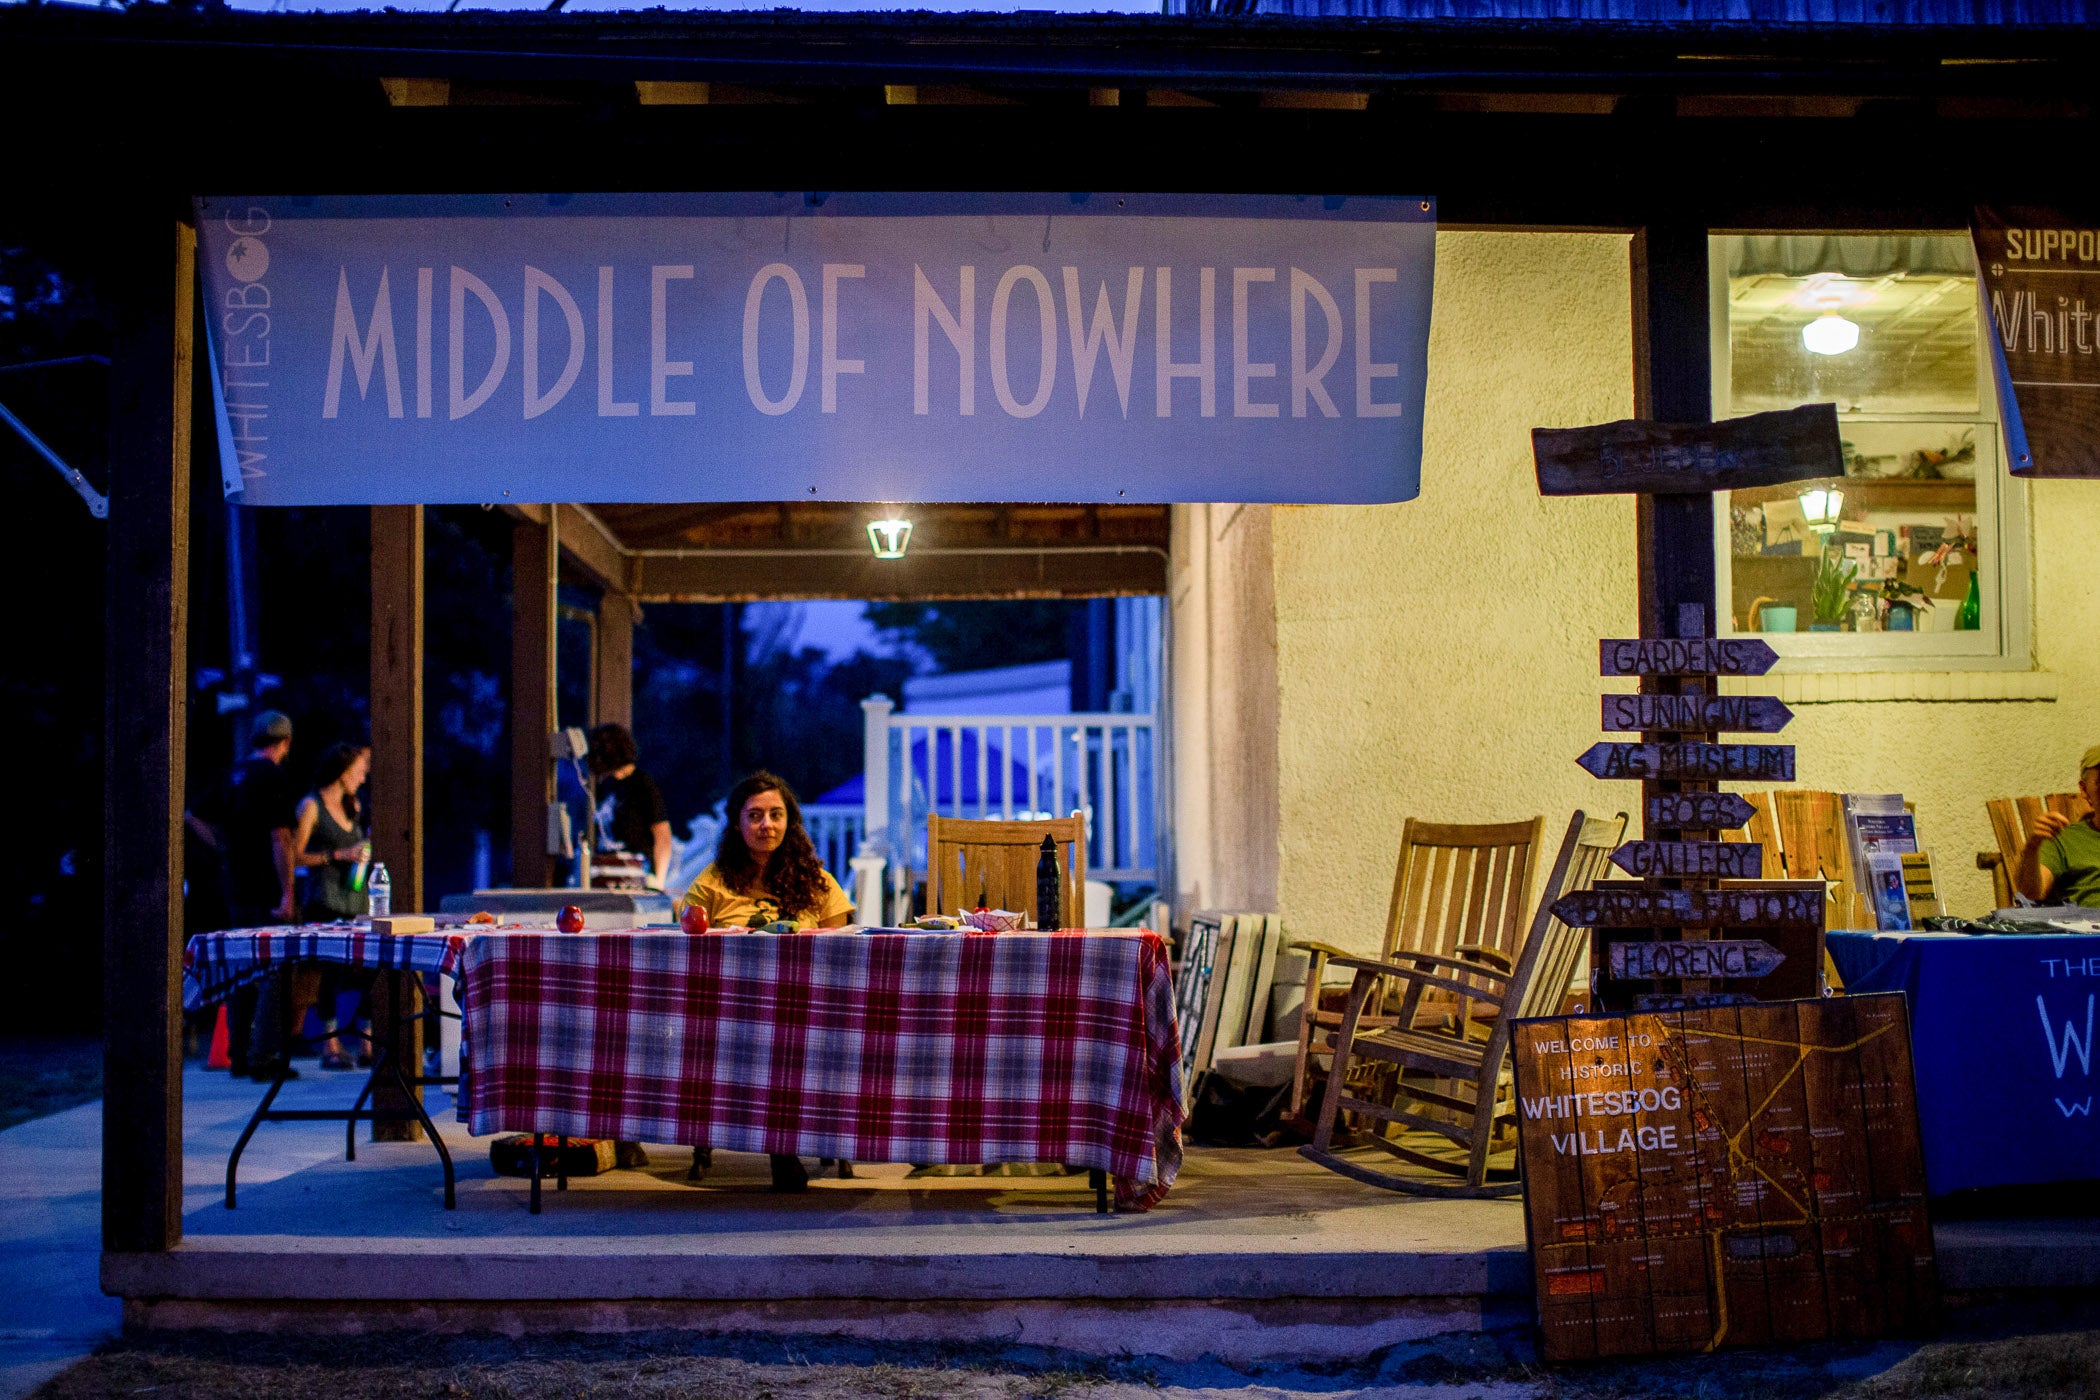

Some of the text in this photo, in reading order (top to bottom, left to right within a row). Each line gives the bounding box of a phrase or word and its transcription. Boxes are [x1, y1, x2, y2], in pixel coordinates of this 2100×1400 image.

[2006, 229, 2100, 261] SUPPO
[1992, 291, 2100, 354] Whit
[322, 262, 1401, 420] MIDDLE OF NOWHERE
[1614, 640, 1743, 674] GARDENS
[1616, 696, 1762, 730] SUNINGIVE
[1605, 743, 1786, 778] AG MUSEUM
[1659, 795, 1736, 829] BOGS
[1633, 842, 1753, 877] GALLERY
[1624, 944, 1760, 976] FLORENCE
[2040, 957, 2100, 979] THE
[1534, 1033, 1652, 1055] WELCOME TO
[1560, 1061, 1643, 1081] HISTORIC
[1521, 1085, 1682, 1121] WHITESBOG
[1550, 1125, 1679, 1157] VILLAGE
